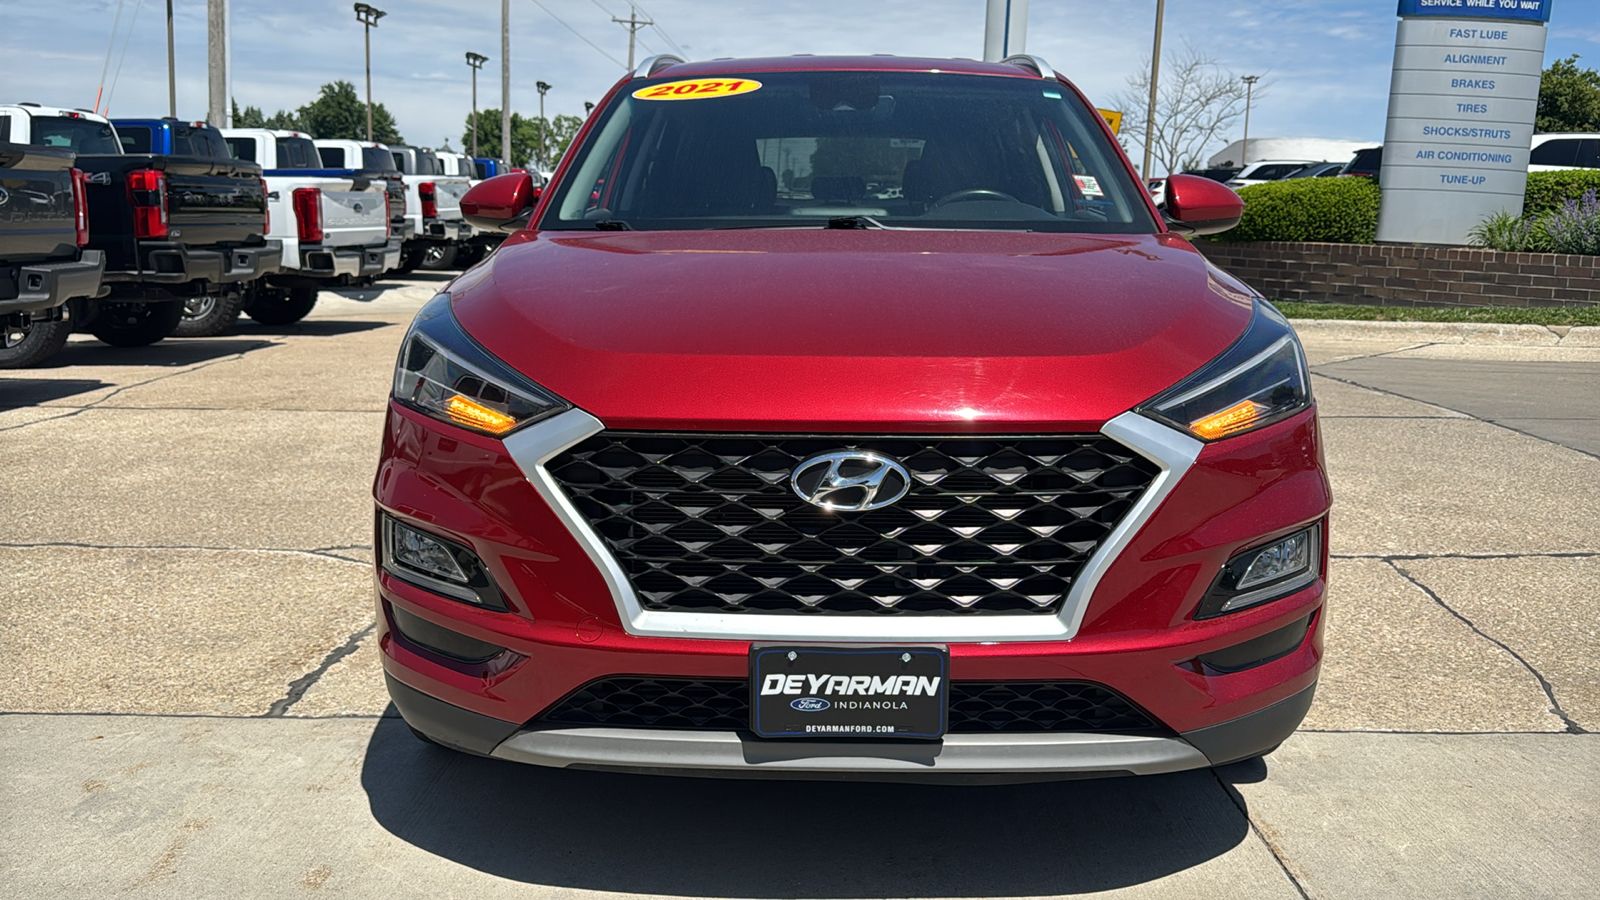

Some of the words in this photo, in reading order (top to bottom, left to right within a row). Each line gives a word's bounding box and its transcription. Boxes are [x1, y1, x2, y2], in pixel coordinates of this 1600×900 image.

[1466, 0, 1495, 8] WHILE
[1499, 0, 1517, 9] YOU
[1520, 2, 1540, 10] WAIT
[1449, 28, 1478, 39] FAST
[1479, 30, 1508, 40] LUBE
[1444, 54, 1507, 66] ALIGNMENT
[646, 81, 744, 98] 2021
[1451, 78, 1495, 90] BRAKES
[1456, 103, 1488, 114] TIRES
[1423, 126, 1511, 140] SHOCKS/STRUTS
[1416, 150, 1435, 160] AIR
[1437, 151, 1512, 164] CONDITIONING
[1440, 174, 1486, 185] TUNE-UP
[760, 674, 941, 696] DEYARMAN
[798, 699, 822, 710] Ford
[834, 701, 908, 709] INDIANOLA
[805, 724, 895, 733] DEYARMANFORD.COM
